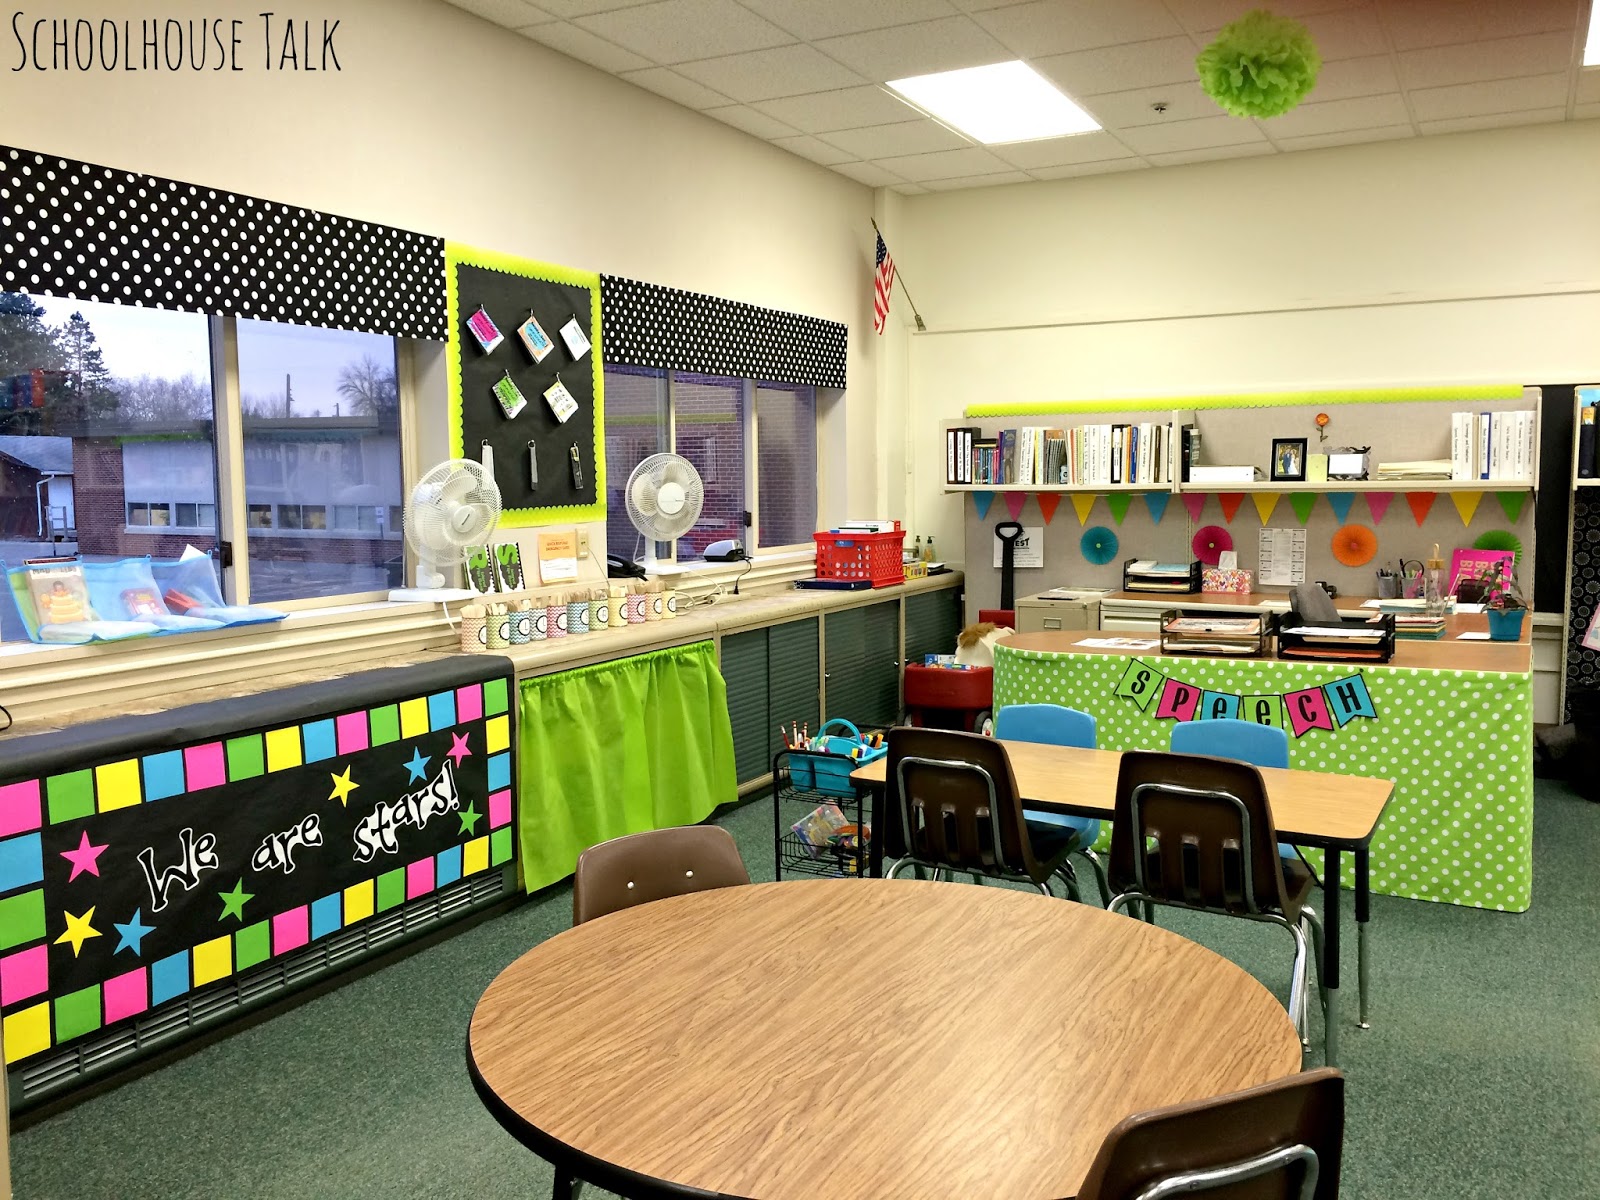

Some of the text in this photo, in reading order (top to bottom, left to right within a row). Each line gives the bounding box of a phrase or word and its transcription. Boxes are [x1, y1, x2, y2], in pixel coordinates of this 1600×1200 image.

[137, 759, 461, 912] We are stars!
